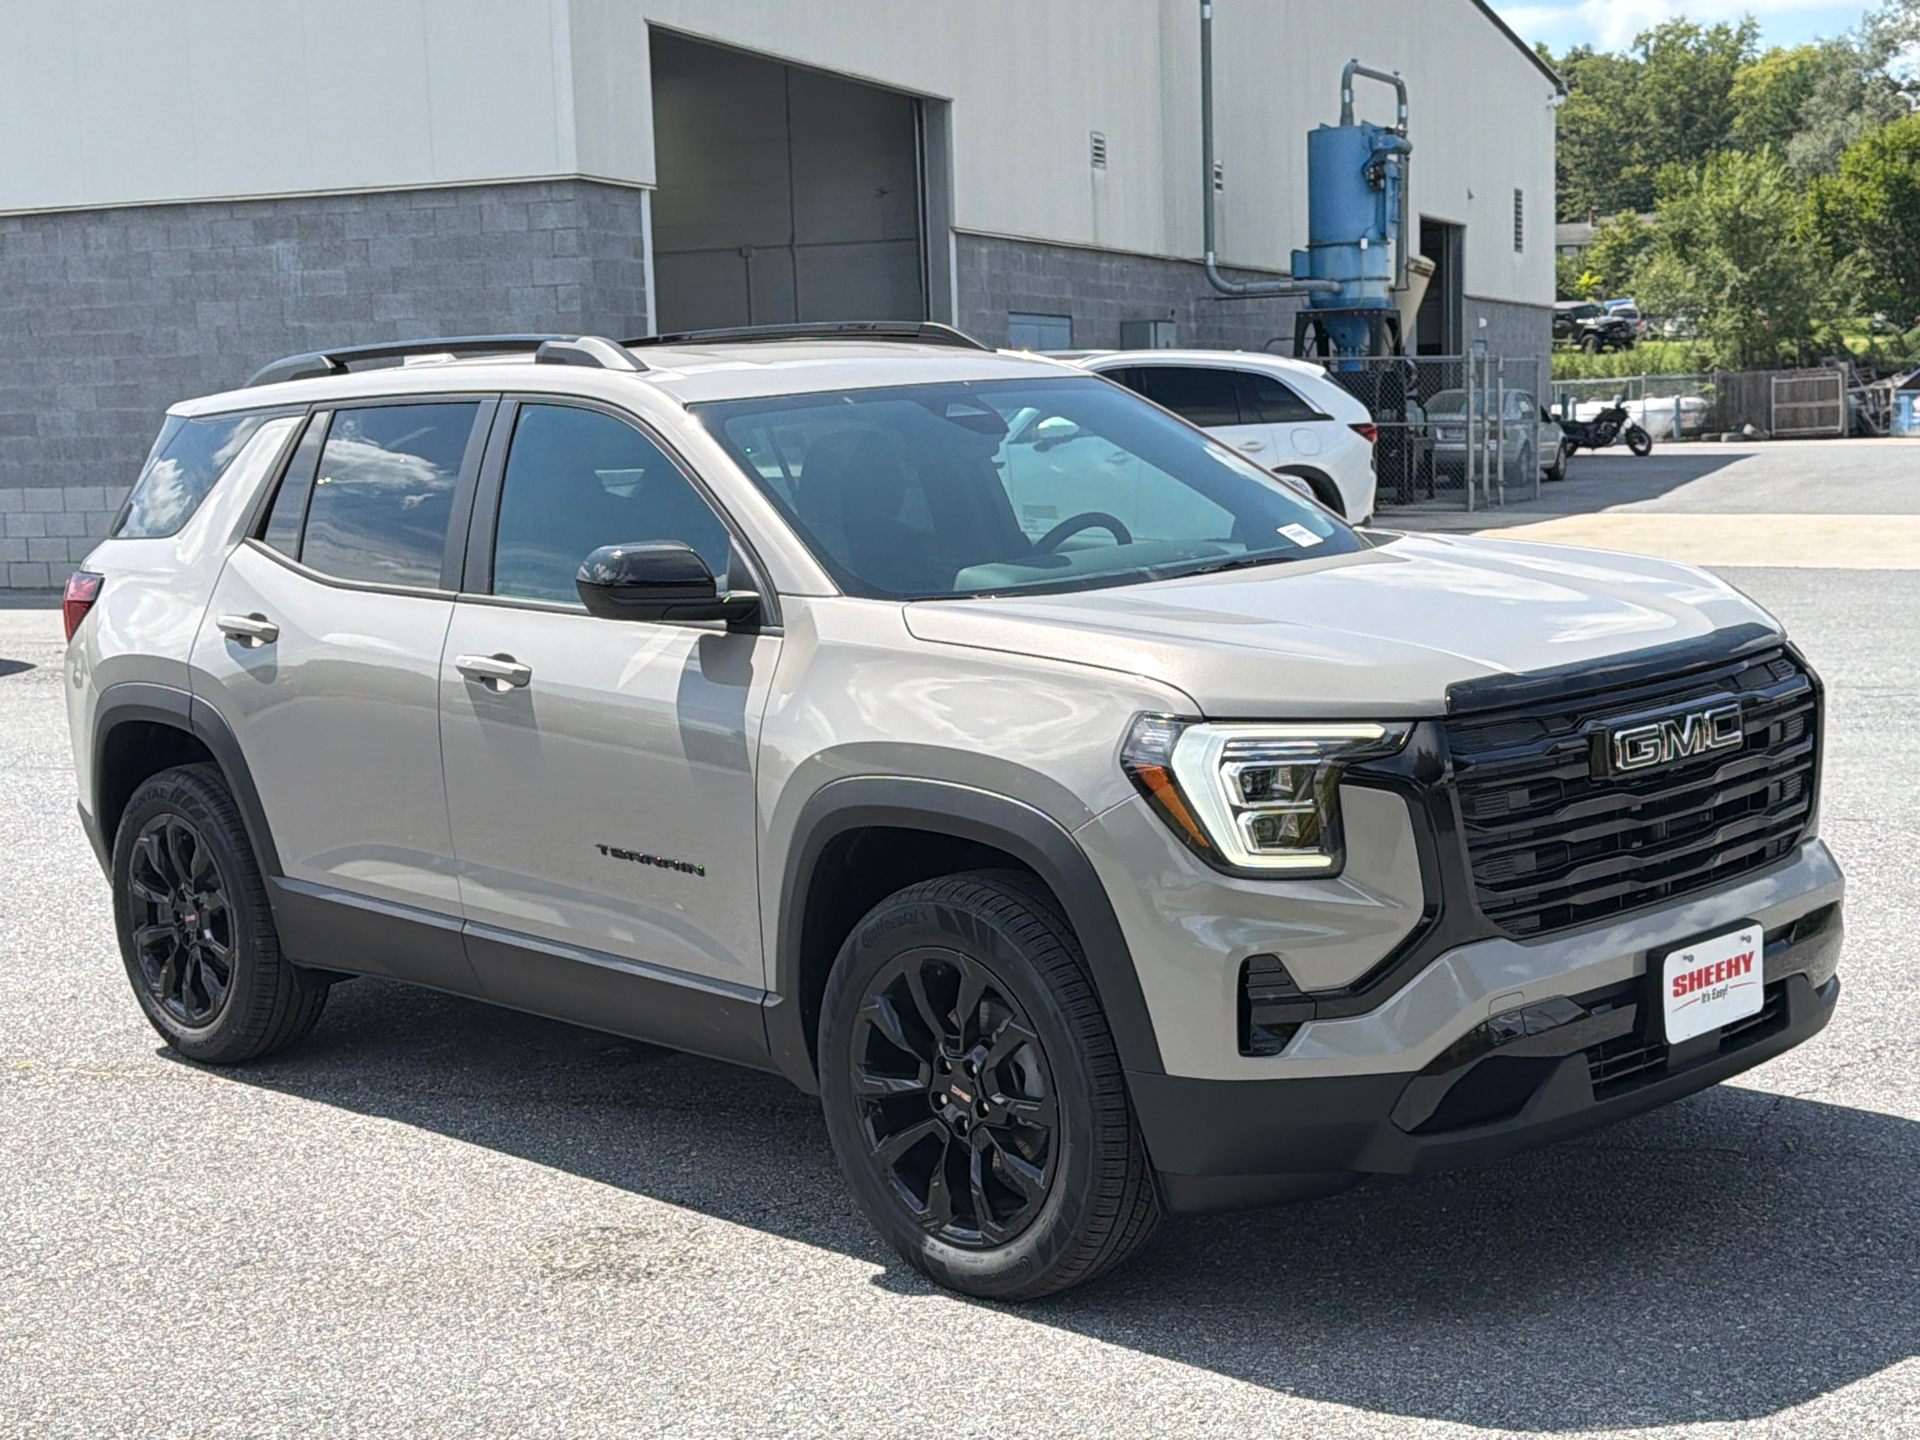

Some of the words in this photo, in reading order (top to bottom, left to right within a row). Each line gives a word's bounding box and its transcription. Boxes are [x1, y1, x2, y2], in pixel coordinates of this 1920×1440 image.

[1614, 703, 1743, 771] GMC
[594, 843, 705, 877] TERRAIN
[1672, 950, 1755, 998] SHEEHY
[1701, 990, 1711, 1004] It's
[1711, 984, 1729, 1001] Easy!
